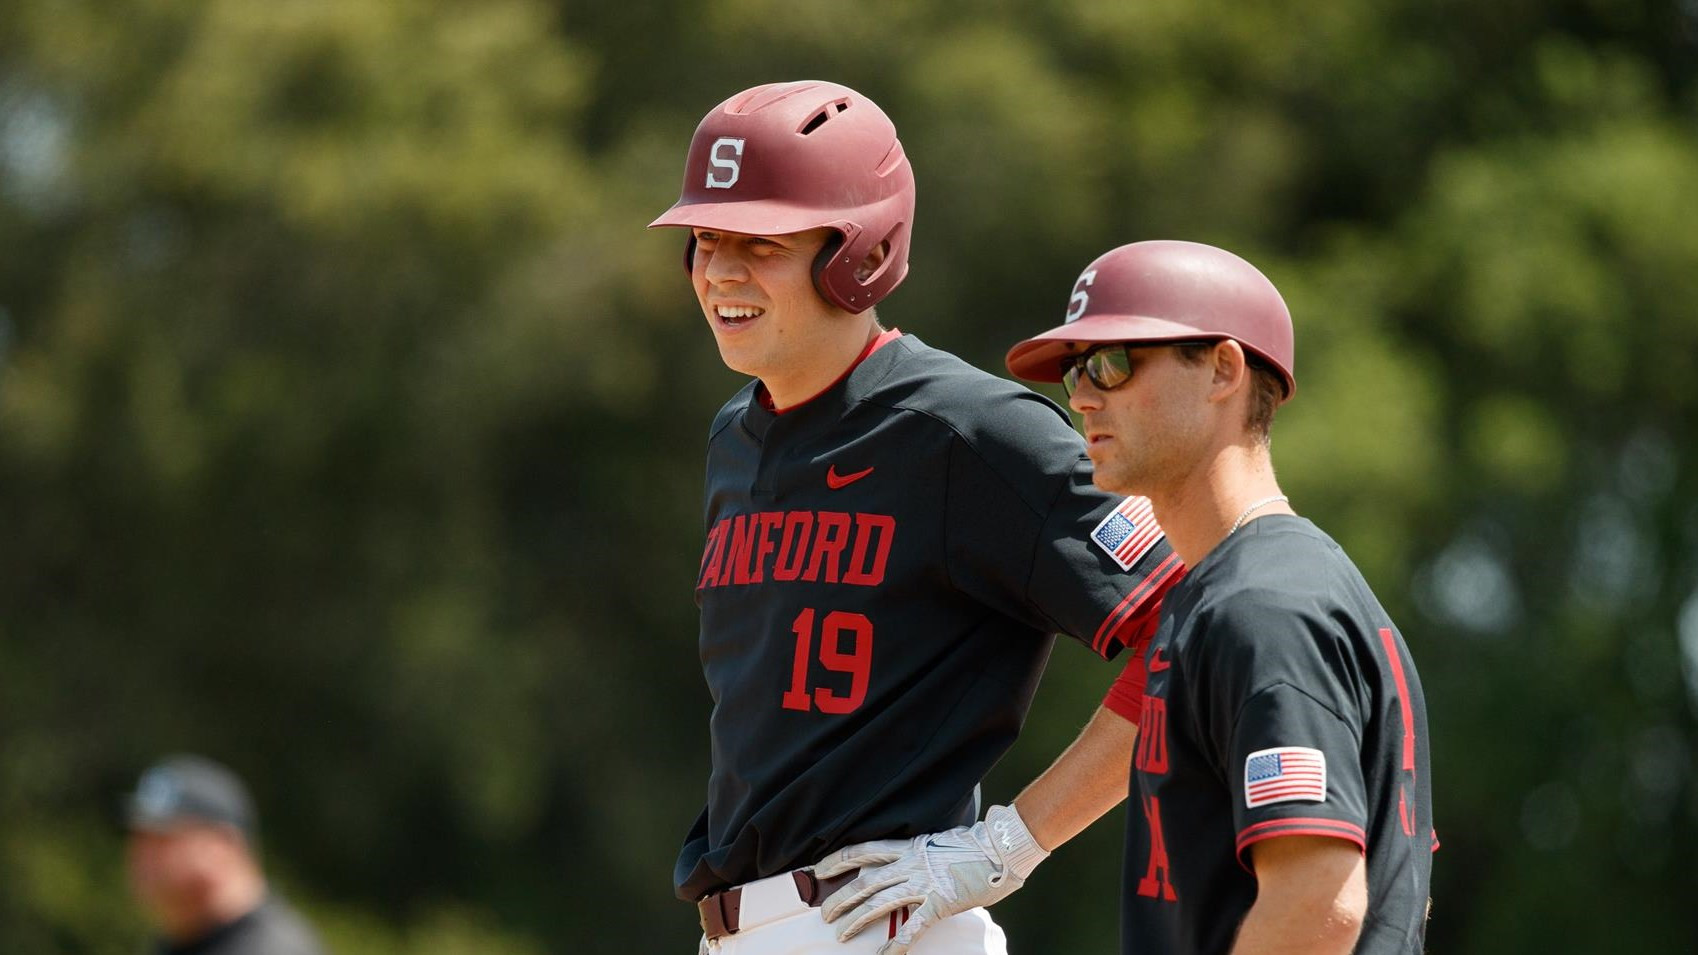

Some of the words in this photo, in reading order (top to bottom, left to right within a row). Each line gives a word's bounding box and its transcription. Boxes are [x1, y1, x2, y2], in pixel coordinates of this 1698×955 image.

[706, 139, 745, 189] S
[1064, 269, 1098, 325] S
[781, 607, 874, 715] 19
